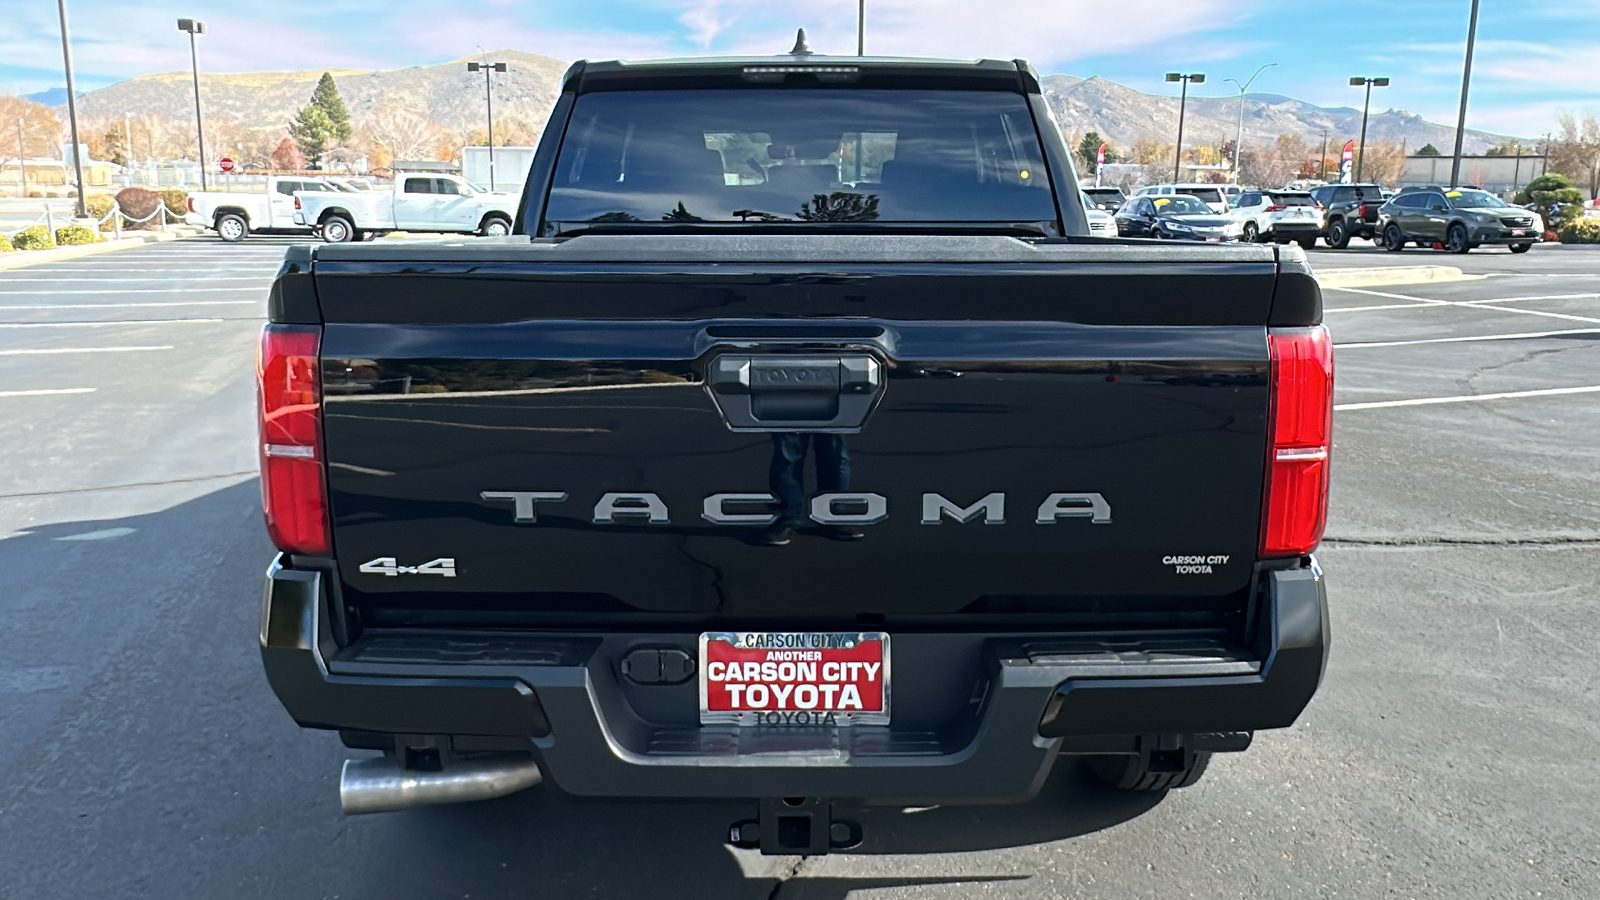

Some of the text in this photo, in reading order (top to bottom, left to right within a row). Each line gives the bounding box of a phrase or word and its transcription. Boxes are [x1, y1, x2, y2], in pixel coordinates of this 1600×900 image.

[754, 368, 836, 384] TOYOTA
[480, 490, 1112, 524] TACOMA
[1162, 555, 1229, 564] CARSON CITY
[1175, 565, 1212, 574] TOYOTA
[745, 633, 845, 648] CARSON CITY
[766, 651, 822, 661] ANOTHER
[708, 662, 881, 682] CARSON CITY
[725, 684, 863, 709] TOYOTA
[754, 711, 837, 725] TOYOTA
